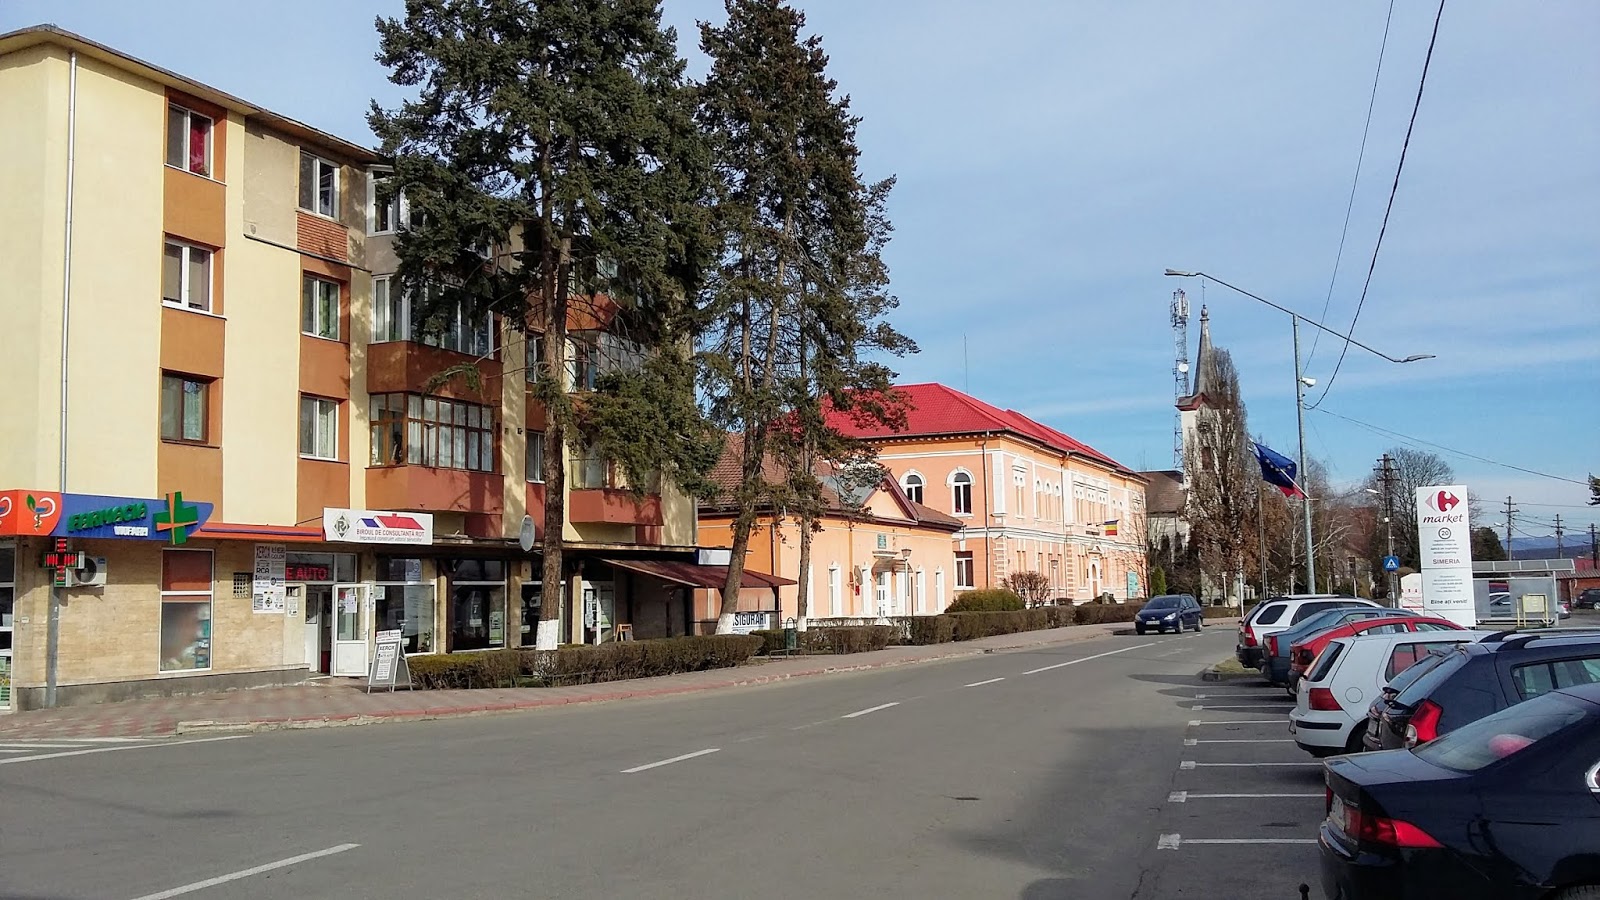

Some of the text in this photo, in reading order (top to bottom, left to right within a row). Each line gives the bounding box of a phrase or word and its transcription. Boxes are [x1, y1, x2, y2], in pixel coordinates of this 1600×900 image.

[68, 502, 147, 532] FARMACIA
[1423, 514, 1464, 523] market
[357, 528, 374, 536] BIROUL
[296, 567, 328, 580] AUTO
